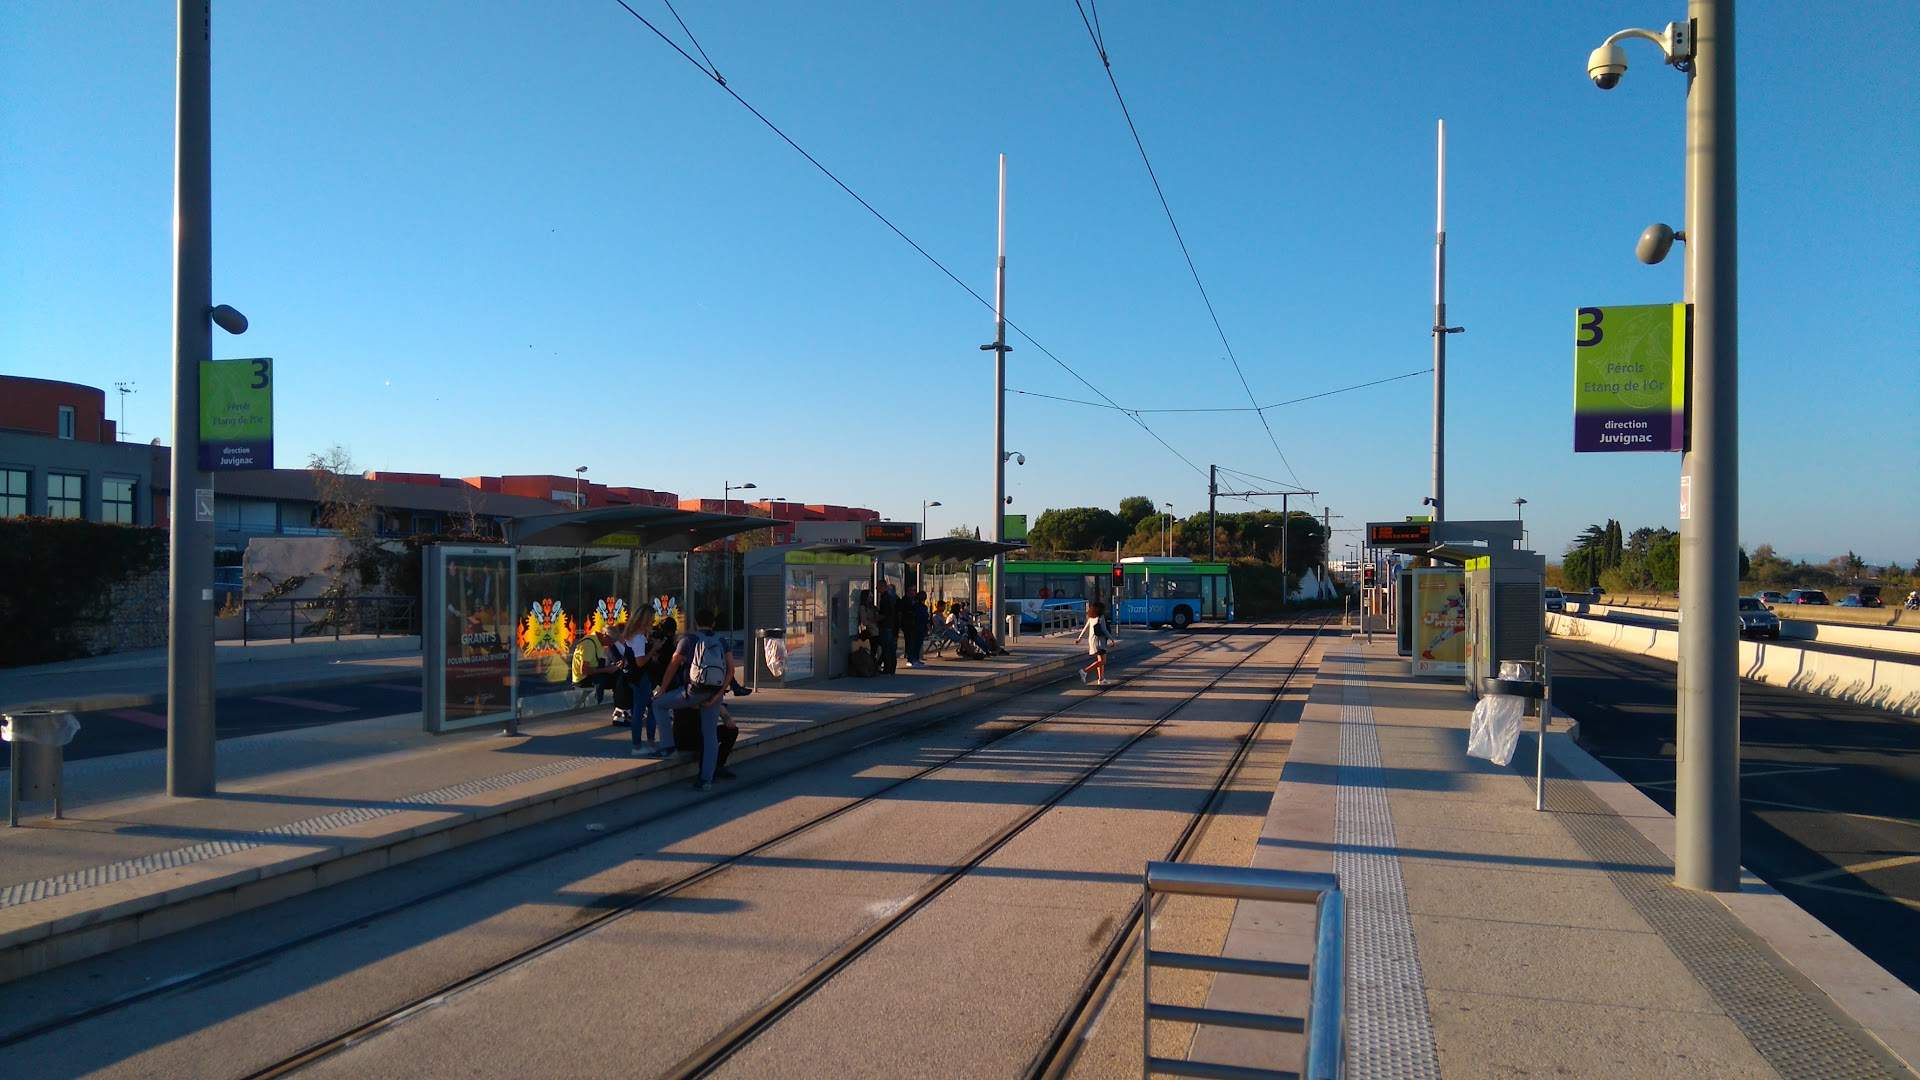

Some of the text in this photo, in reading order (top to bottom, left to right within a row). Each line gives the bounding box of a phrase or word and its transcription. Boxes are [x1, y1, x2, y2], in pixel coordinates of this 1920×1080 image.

[1577, 307, 1604, 347] 3
[250, 358, 270, 390] 3
[1624, 379, 1639, 391] de
[1604, 419, 1648, 430] direction
[1599, 433, 1653, 445] Juvignac
[223, 447, 251, 455] direction
[220, 457, 254, 467] Juvignac
